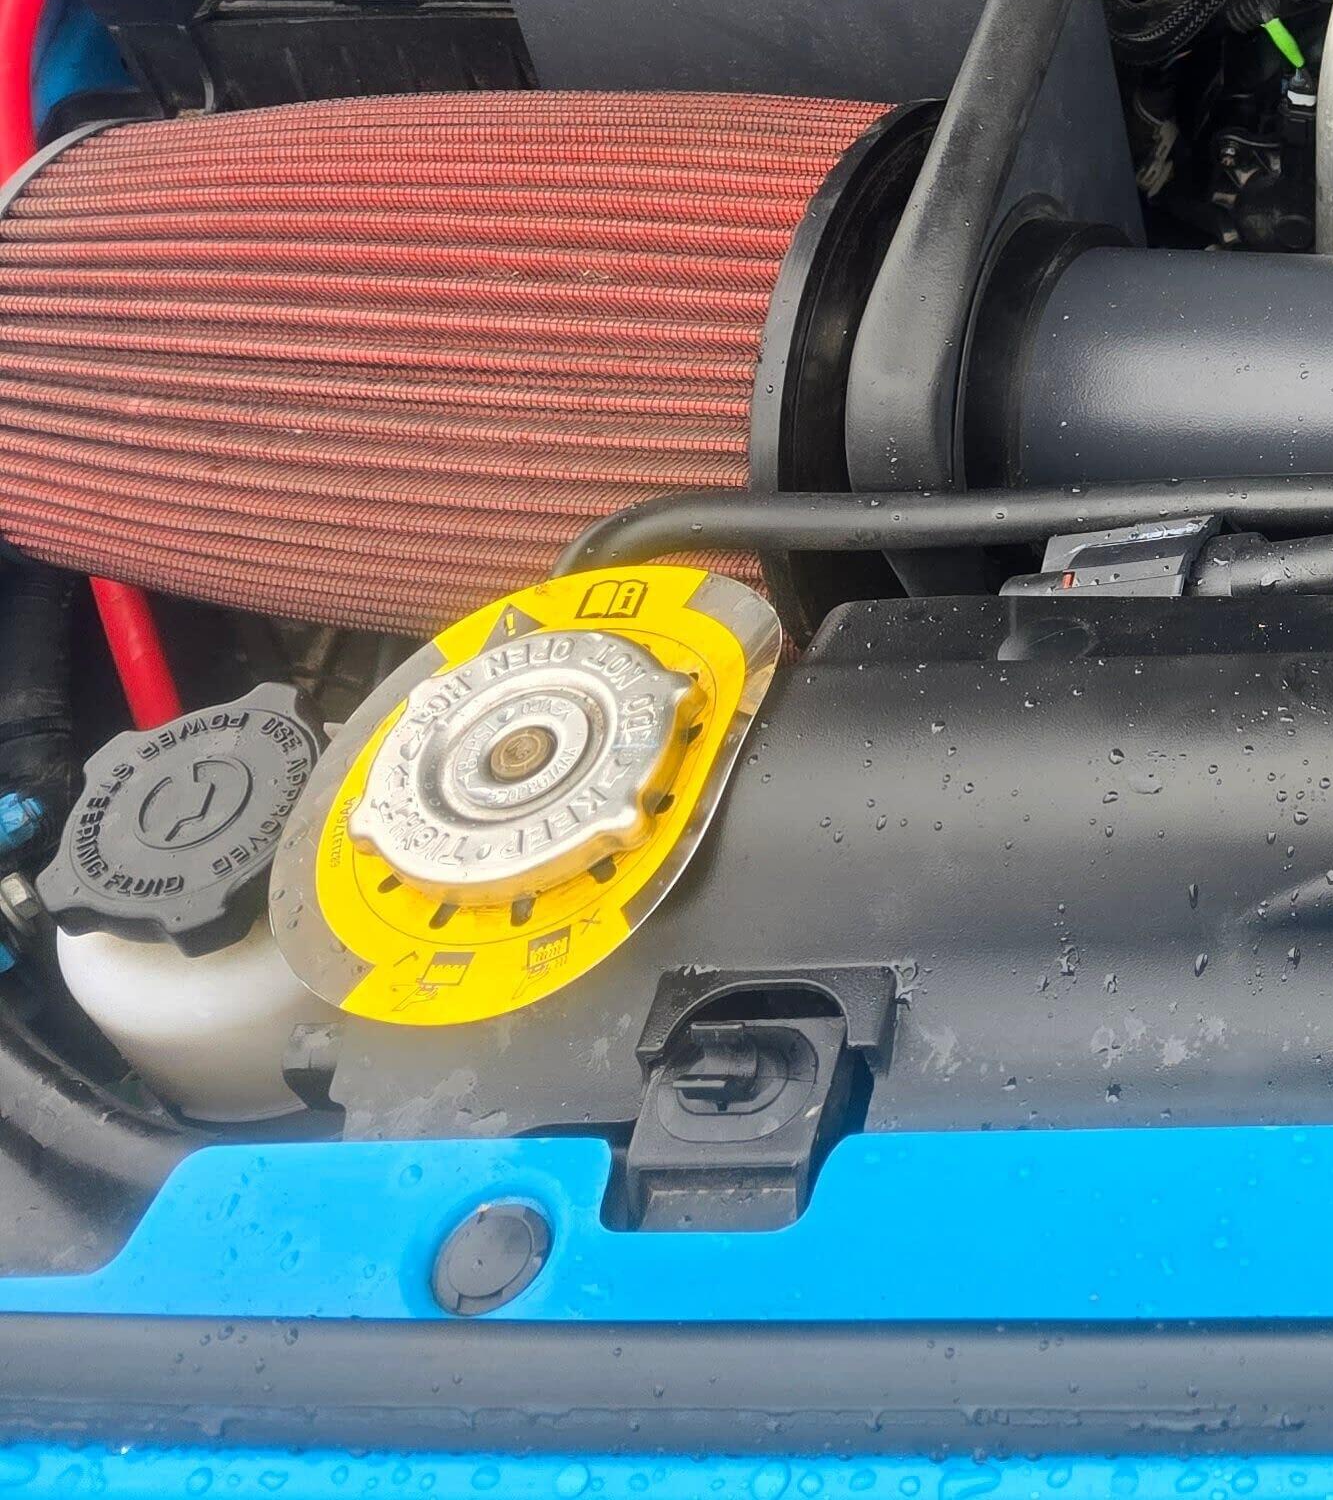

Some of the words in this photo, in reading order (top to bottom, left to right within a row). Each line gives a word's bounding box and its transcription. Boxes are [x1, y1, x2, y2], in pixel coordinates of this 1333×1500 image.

[482, 635, 577, 682] OPEN
[579, 643, 647, 692] NOT
[137, 711, 250, 762] POWER
[259, 716, 303, 753] USE
[76, 762, 136, 881] STEERING
[211, 757, 309, 876] APPROVED
[499, 786, 607, 861] KEEP
[103, 874, 185, 897] FLUID
